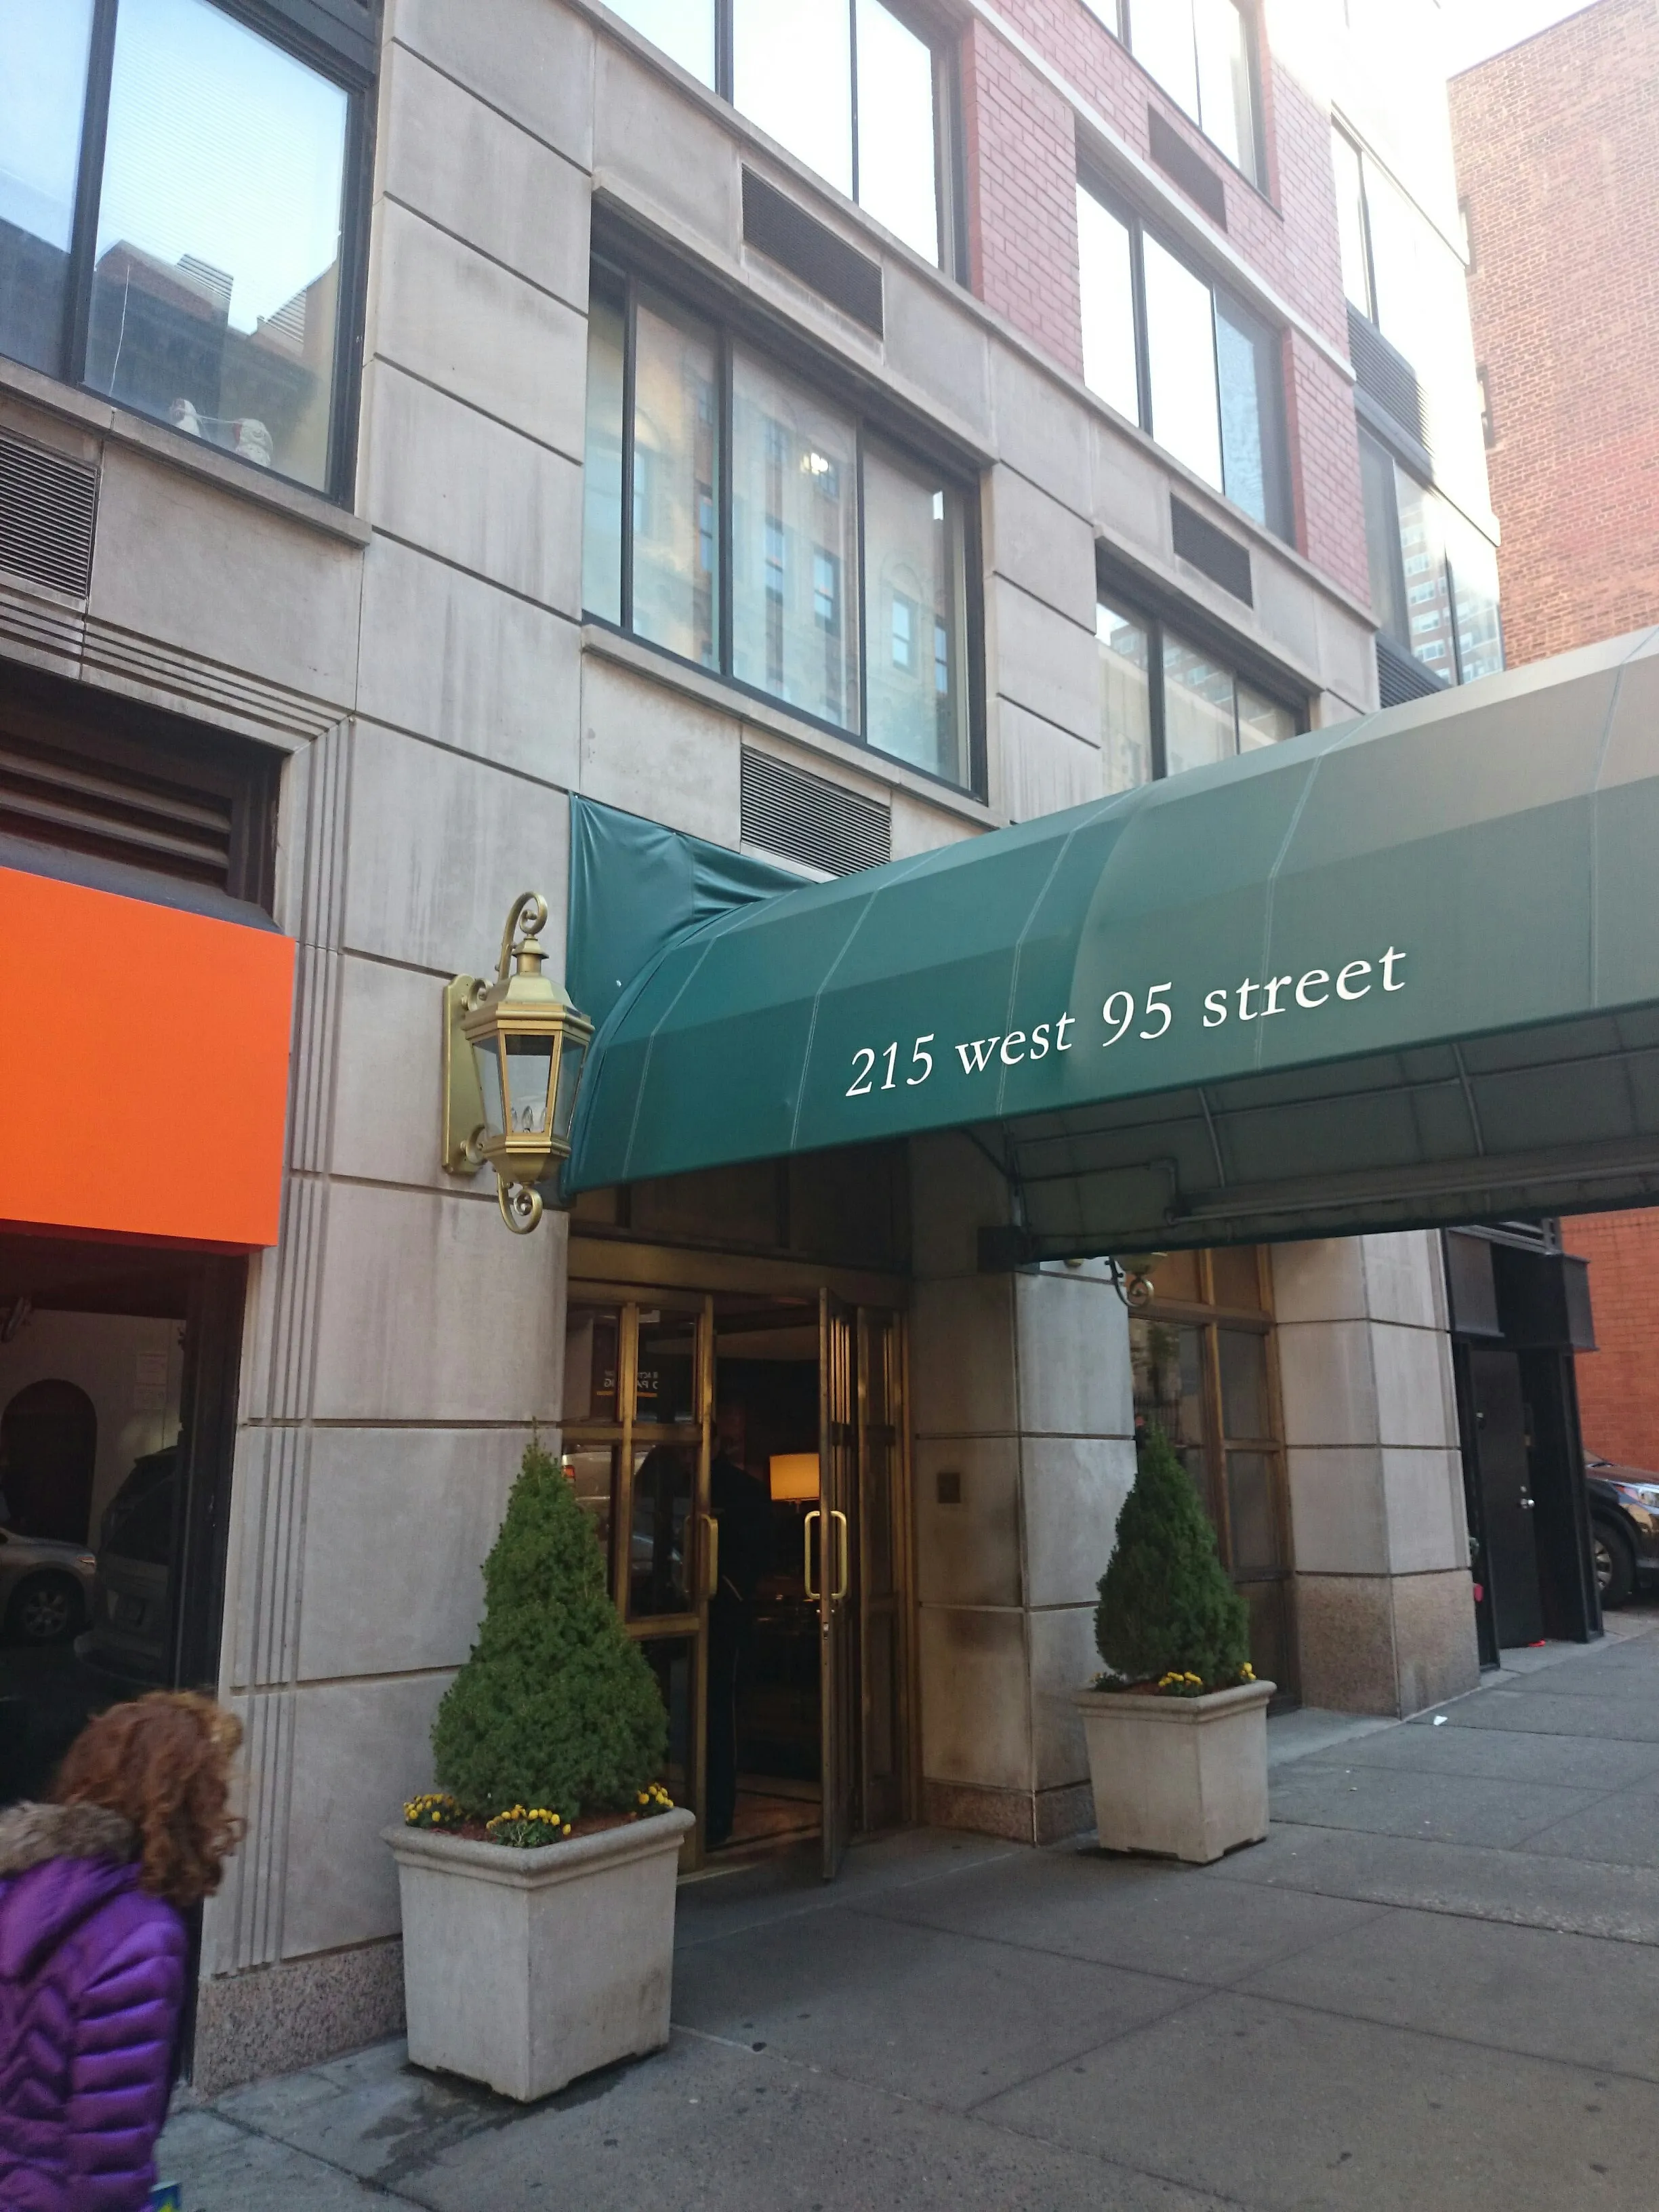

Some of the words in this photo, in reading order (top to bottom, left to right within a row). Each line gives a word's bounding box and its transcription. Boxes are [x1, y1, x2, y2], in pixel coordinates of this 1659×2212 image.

[844, 1033, 936, 1097] 215
[954, 1010, 1076, 1076] west
[1101, 981, 1173, 1048] 95
[1202, 945, 1408, 1028] street
